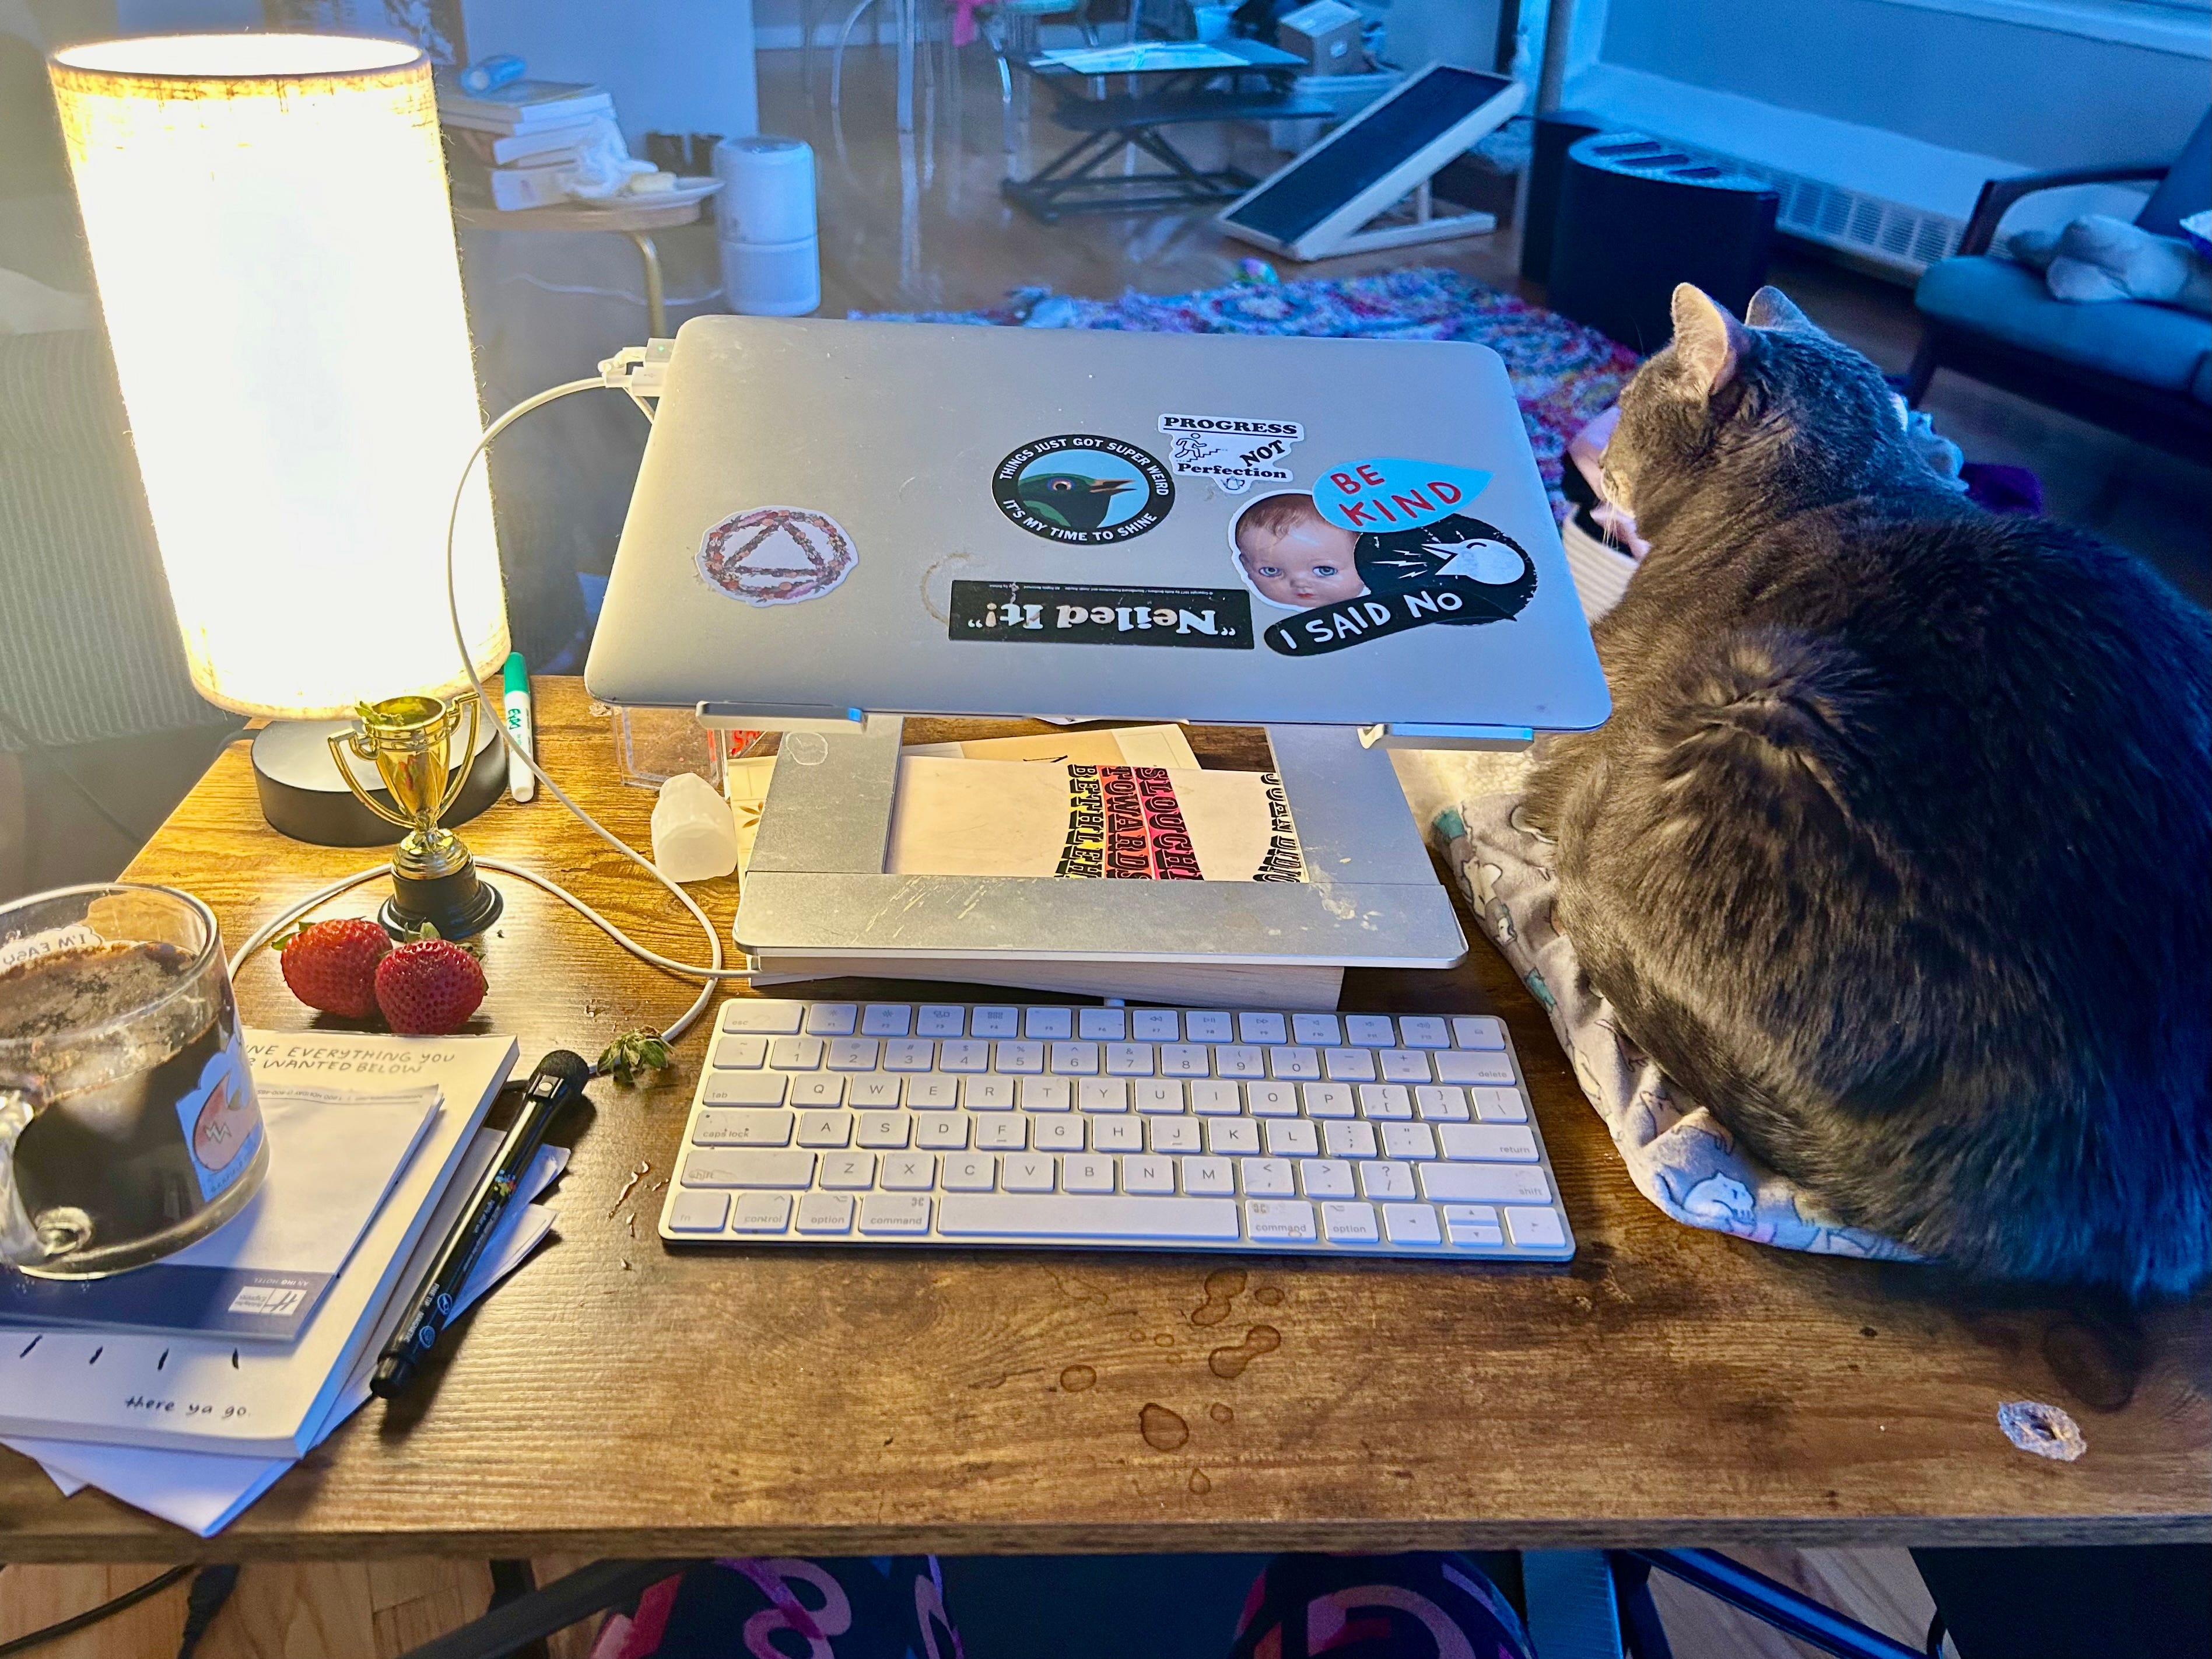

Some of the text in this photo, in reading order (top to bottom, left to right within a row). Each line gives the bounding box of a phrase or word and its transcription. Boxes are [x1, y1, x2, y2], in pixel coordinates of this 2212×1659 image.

[1164, 416, 1298, 435] PROGRESS
[1240, 440, 1285, 467] NOT
[999, 438, 1169, 496] THINGS JUST GOT SUPER WEIRD
[1177, 463, 1287, 479] Perfection
[1330, 464, 1386, 495] BE
[1338, 481, 1463, 527] KIND
[1002, 499, 1158, 541] IT'S MY TIME TO SHINE
[1279, 628, 1298, 650] I
[1305, 601, 1391, 643] SAID
[290, 1045, 411, 1063] EVERYTHING
[419, 1054, 455, 1063] YOU
[849, 1055, 858, 1063] 2
[905, 1055, 913, 1064] 3
[960, 1056, 968, 1065] 4
[1016, 1058, 1025, 1066] 5
[1071, 1058, 1079, 1067] 6
[1126, 1059, 1134, 1068] 7
[1182, 1060, 1190, 1069] 8
[264, 1059, 350, 1072] WANTED
[356, 1062, 423, 1074] BELOW
[1236, 1062, 1246, 1070] 9
[1292, 1063, 1301, 1072] 0
[814, 1084, 825, 1094] Q
[870, 1085, 884, 1094] W
[929, 1086, 938, 1096] E
[986, 1087, 994, 1096] R
[1043, 1088, 1052, 1097] T
[1099, 1089, 1108, 1098] Y
[1155, 1091, 1165, 1100] U
[1268, 1093, 1278, 1102] O
[1324, 1094, 1334, 1103] P
[821, 1122, 832, 1132] A
[880, 1123, 891, 1133] S
[939, 1124, 949, 1133] D
[998, 1125, 1007, 1135] F
[1055, 1126, 1065, 1136] G
[1113, 1127, 1124, 1137] H
[703, 1130, 727, 1139] caps
[1173, 1128, 1181, 1138] J
[1229, 1129, 1239, 1139] K
[1288, 1132, 1298, 1141] L
[1500, 1145, 1530, 1154] return
[843, 1163, 854, 1174] Z
[903, 1164, 915, 1174] X
[965, 1165, 975, 1175] C
[1025, 1166, 1035, 1175] V
[1085, 1167, 1094, 1177] B
[1144, 1168, 1154, 1178] N
[1382, 1166, 1390, 1177] ?
[1203, 1169, 1215, 1180] M
[1519, 1187, 1543, 1196] shift
[744, 1214, 783, 1224] control
[811, 1214, 844, 1226] option
[870, 1216, 922, 1225] command
[1255, 1224, 1306, 1233] command
[1333, 1225, 1366, 1234] option
[125, 1395, 175, 1412] there
[185, 1404, 213, 1416] ya
